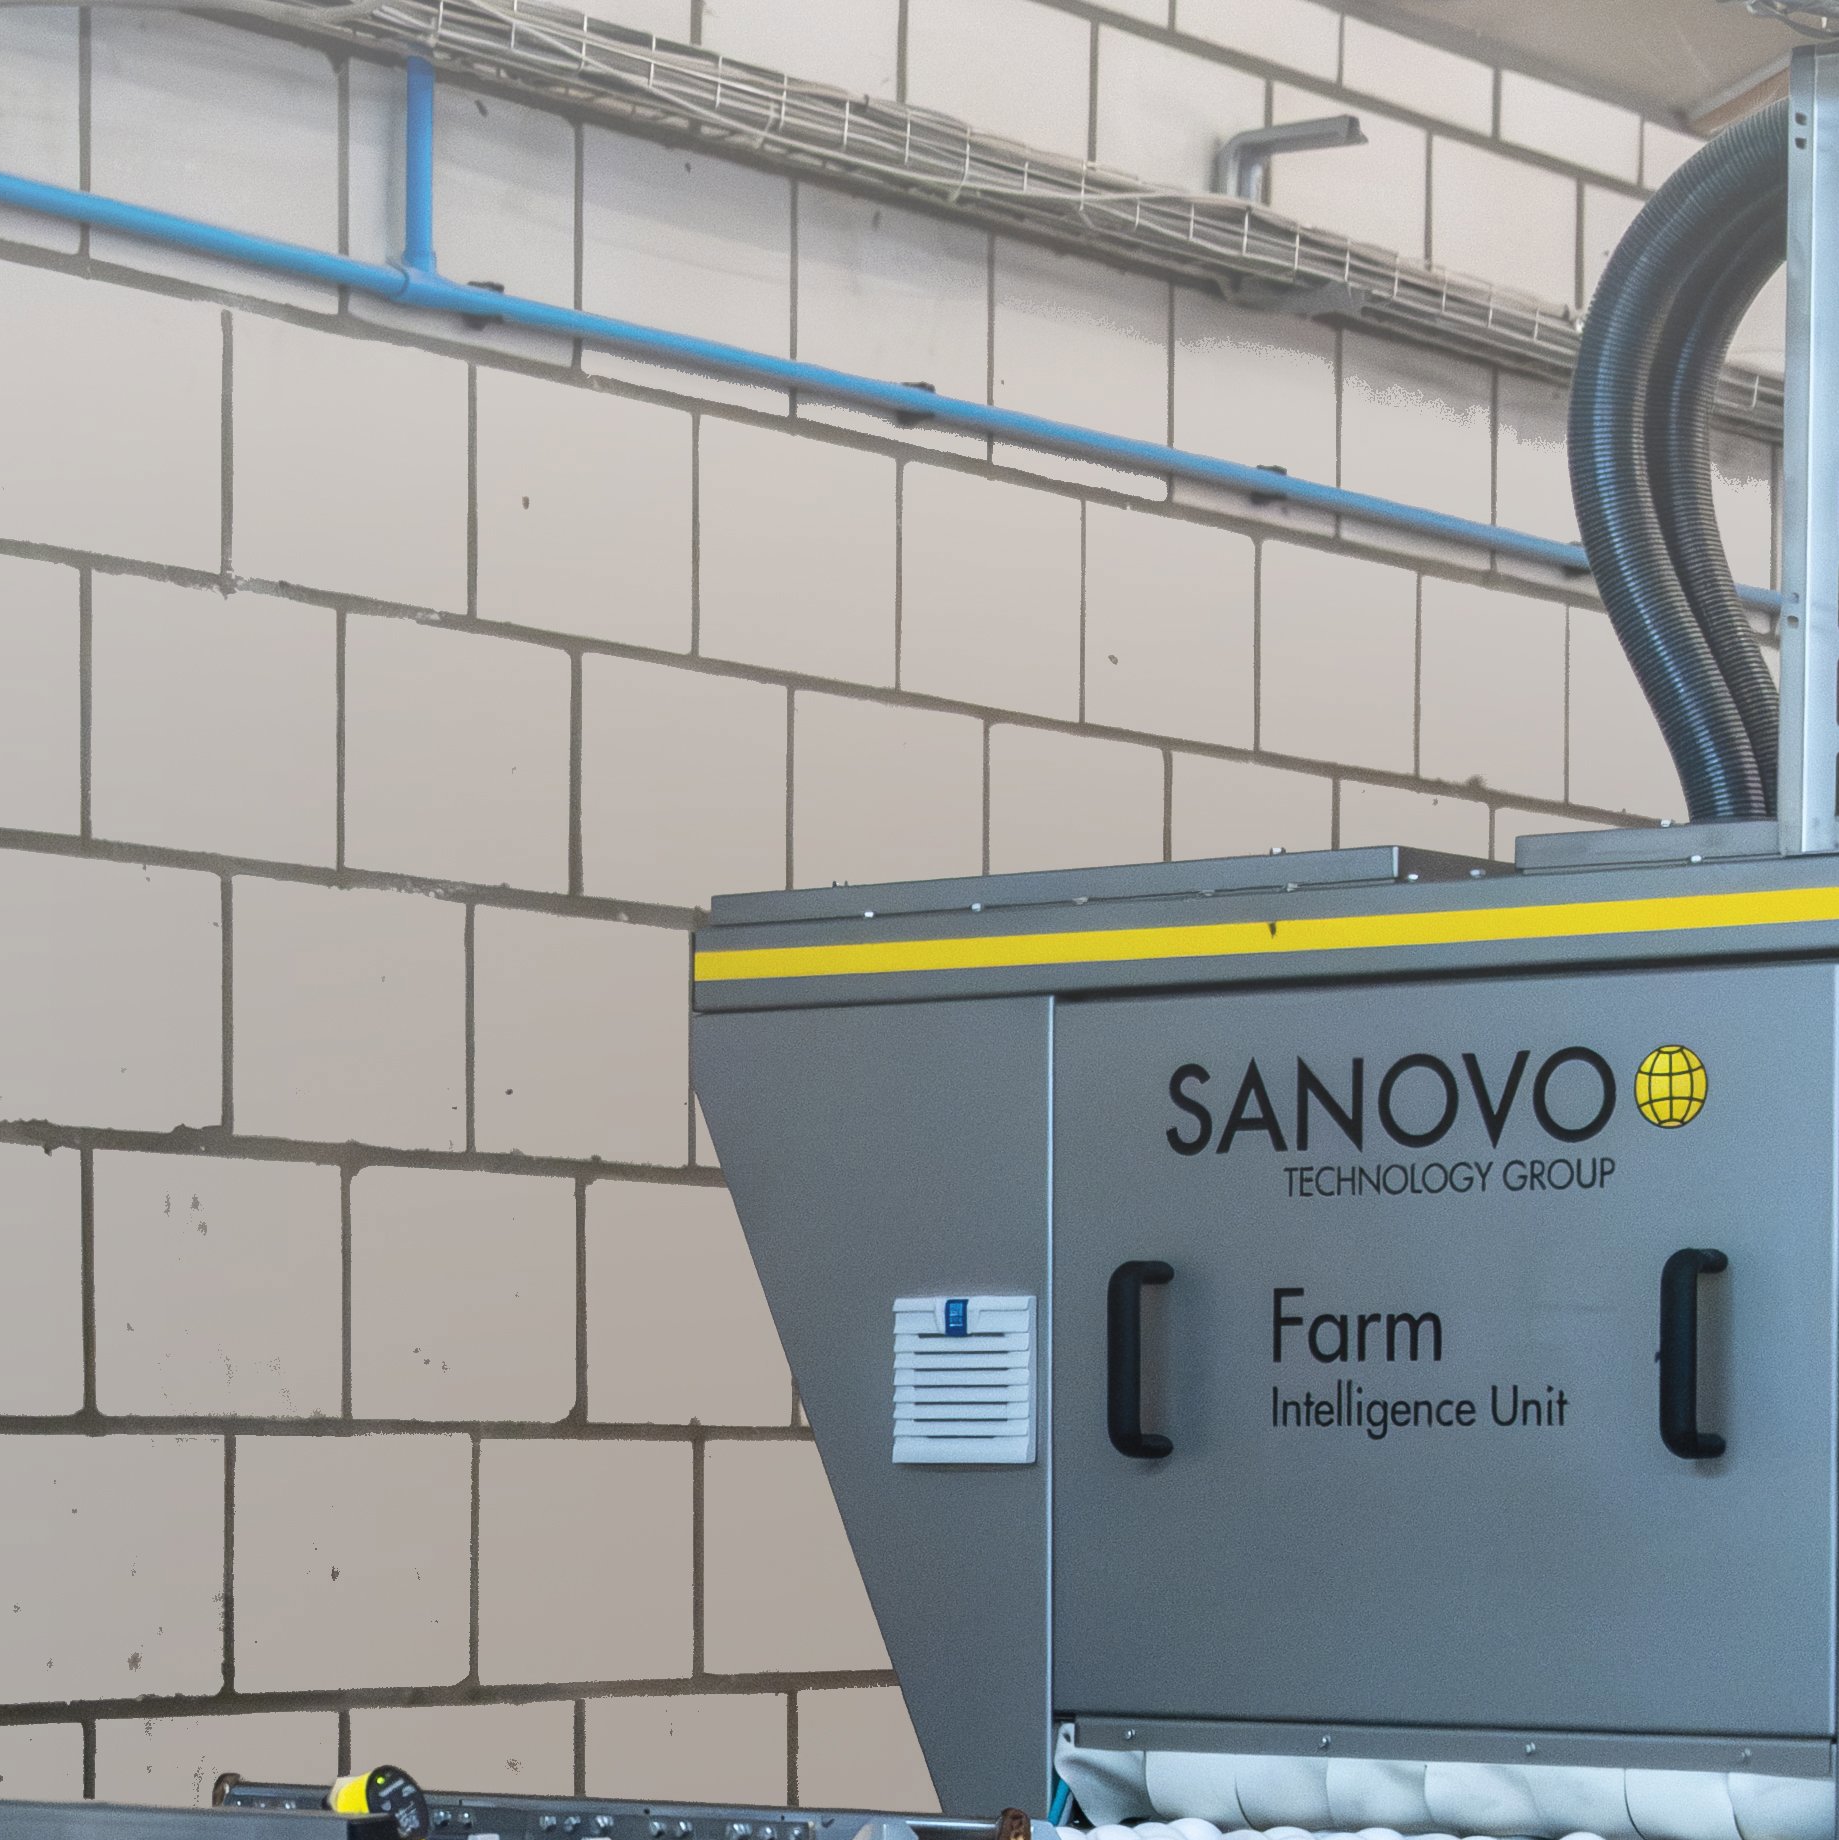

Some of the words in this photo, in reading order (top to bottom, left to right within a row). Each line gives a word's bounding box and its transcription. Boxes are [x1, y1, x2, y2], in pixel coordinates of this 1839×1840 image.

[1166, 1046, 1617, 1156] SANOVO
[1283, 1161, 1493, 1197] TECHNOLOGY
[1502, 1156, 1616, 1192] GROUP
[1272, 1287, 1443, 1364] Farm
[1272, 1380, 1477, 1440] Intelligence
[1490, 1385, 1570, 1427] Unit
